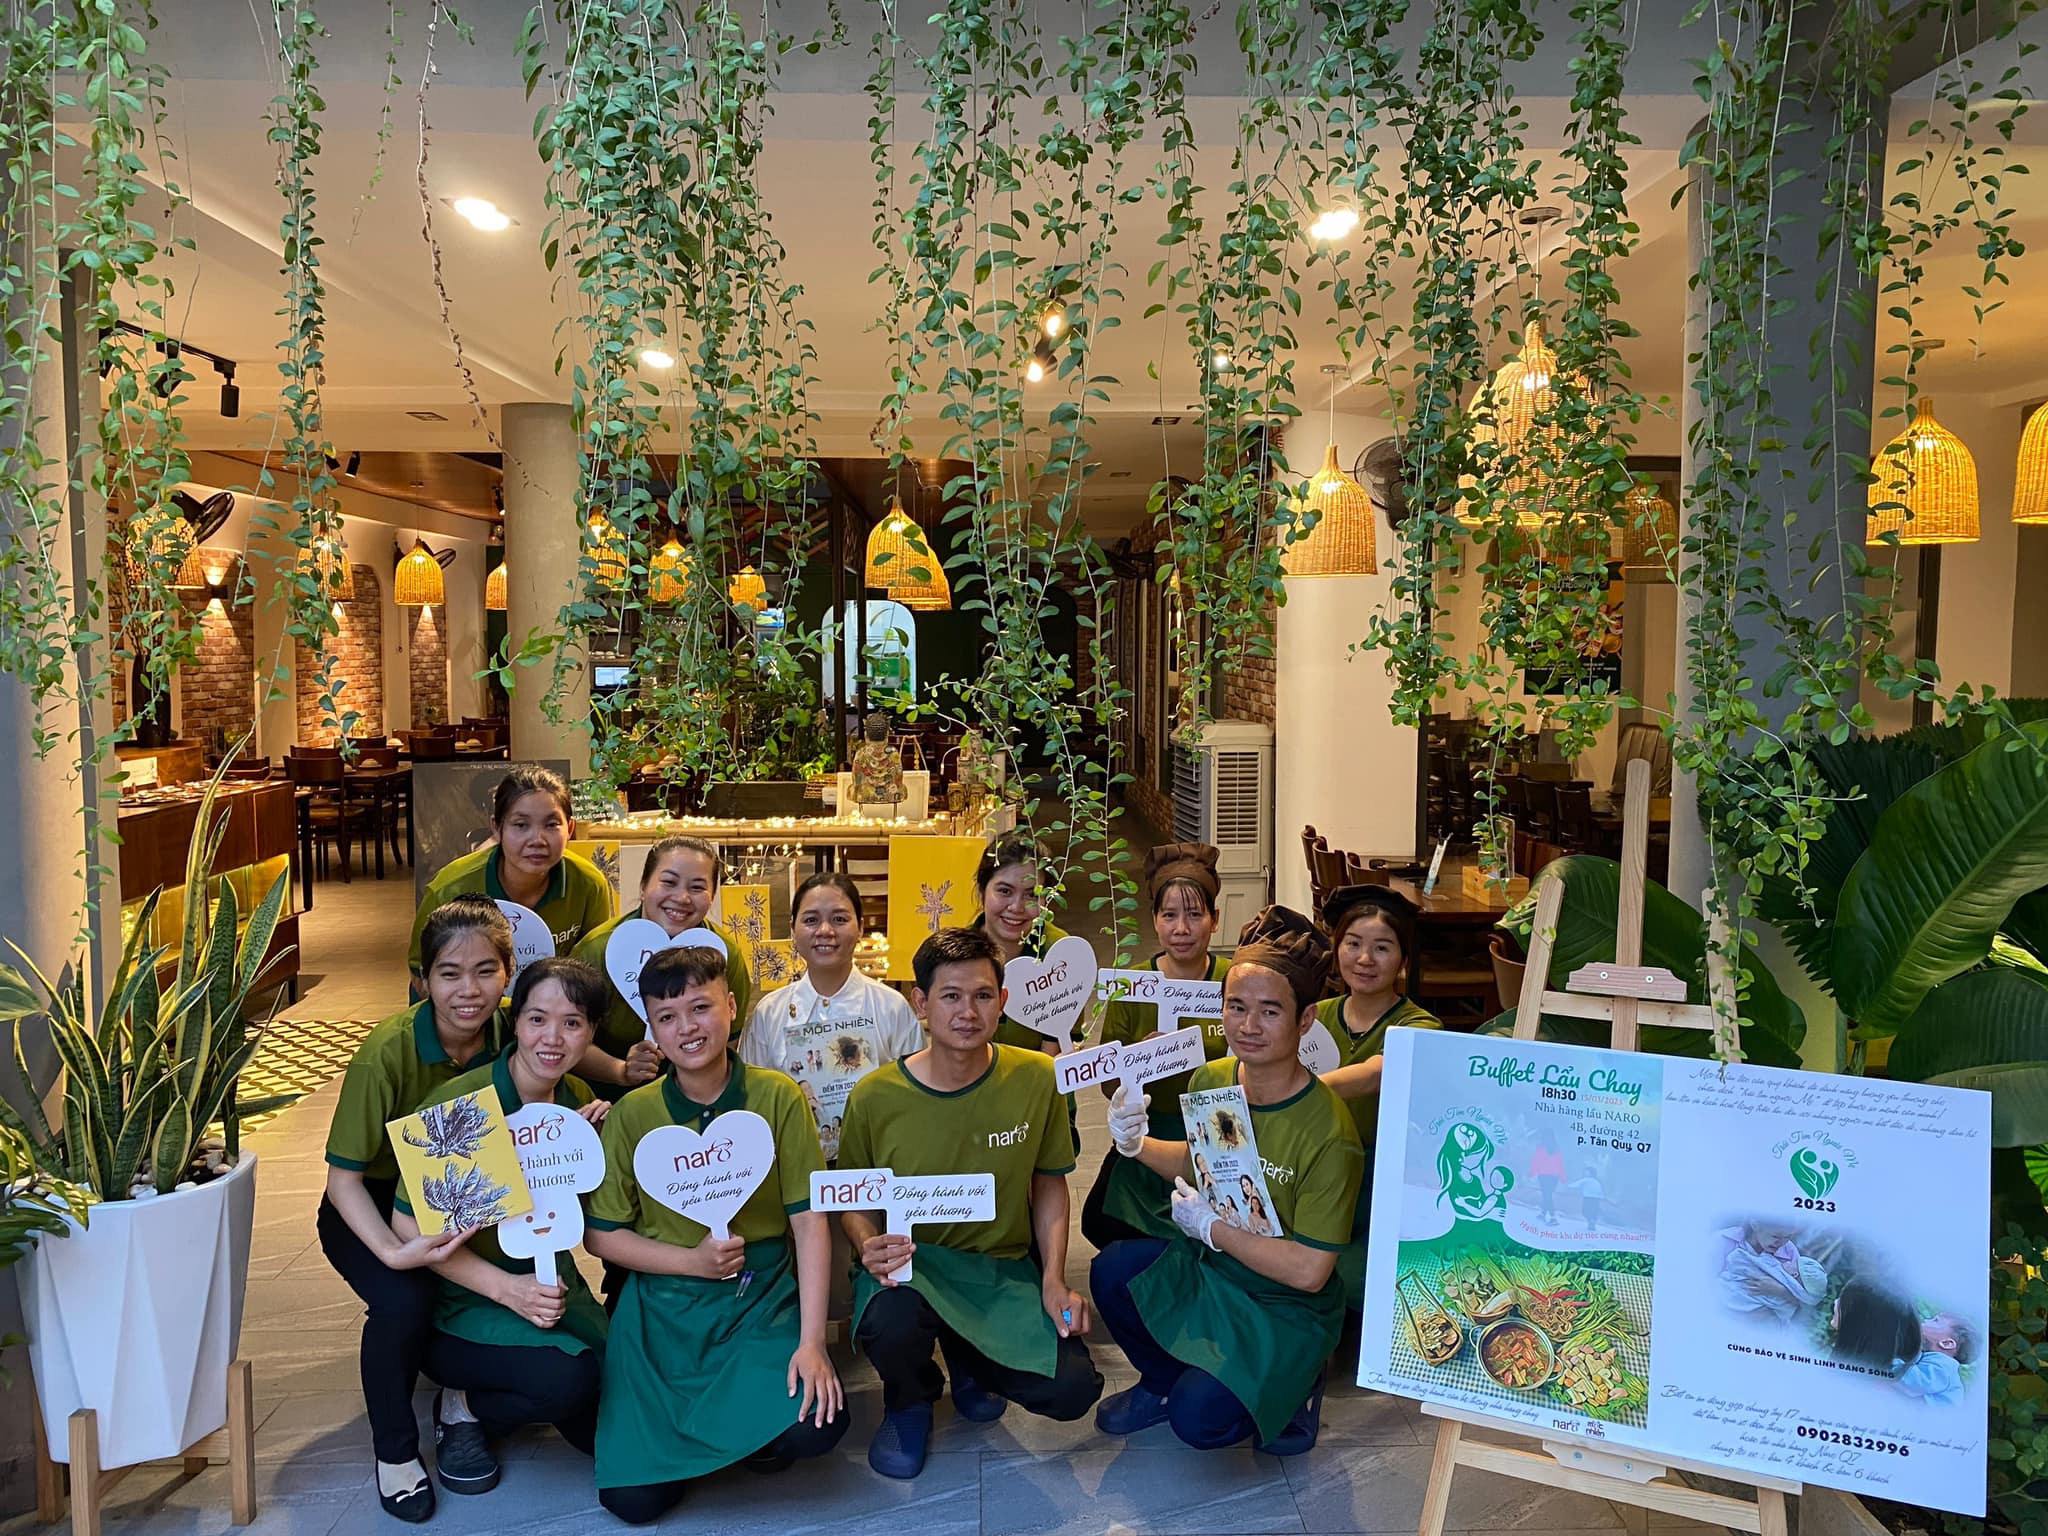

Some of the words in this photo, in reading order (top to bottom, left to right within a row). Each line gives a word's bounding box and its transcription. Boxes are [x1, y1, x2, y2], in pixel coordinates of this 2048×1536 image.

[1025, 960, 1068, 996] naro
[1048, 990, 1068, 1006] hành
[1070, 983, 1083, 997] với
[1172, 1004, 1191, 1014] yêu
[1194, 1002, 1223, 1014] thươn
[835, 1016, 874, 1030] NHIÊN
[1034, 1010, 1050, 1026] yêu
[1154, 1042, 1181, 1060] hành
[1182, 1037, 1198, 1052] với
[1065, 1046, 1118, 1086] naro
[1135, 1068, 1155, 1084] yêu
[1468, 1055, 1535, 1087] Buffet
[1539, 1064, 1580, 1089] Lẩu
[1589, 1070, 1642, 1106] Chay
[1212, 1090, 1240, 1103] NHIÊN
[1542, 1087, 1576, 1101] 18h30
[1535, 1102, 1555, 1113] Nhà
[1558, 1103, 1583, 1119] hàng
[1605, 1110, 1640, 1124] NARO
[988, 1120, 1029, 1148] naro
[1570, 1122, 1587, 1135] 4B,
[1590, 1124, 1624, 1140] đường
[1627, 1130, 1640, 1140] 42
[1577, 1136, 1587, 1145] p.
[1590, 1136, 1607, 1147] Tân
[1636, 1142, 1652, 1153] Q7
[527, 1153, 561, 1169] hành
[564, 1148, 584, 1162] với
[674, 1137, 733, 1173] naro
[528, 1172, 575, 1190] thương
[666, 1180, 700, 1196] Đồng
[703, 1172, 732, 1186] hành
[735, 1166, 752, 1179] với
[820, 1172, 887, 1205] naro
[681, 1195, 702, 1209] yêu
[705, 1187, 744, 1201] thương
[892, 1185, 929, 1201] Đồng
[932, 1184, 965, 1197] hành
[968, 1183, 988, 1196] với
[904, 1207, 928, 1221] yêu
[931, 1205, 974, 1218] thương
[1793, 1197, 1836, 1213] 2023
[1789, 1354, 1811, 1364] SINH
[1814, 1358, 1836, 1369] LINH
[1796, 1425, 1910, 1457] 0902832996
[1839, 1450, 1862, 1466] Q7
